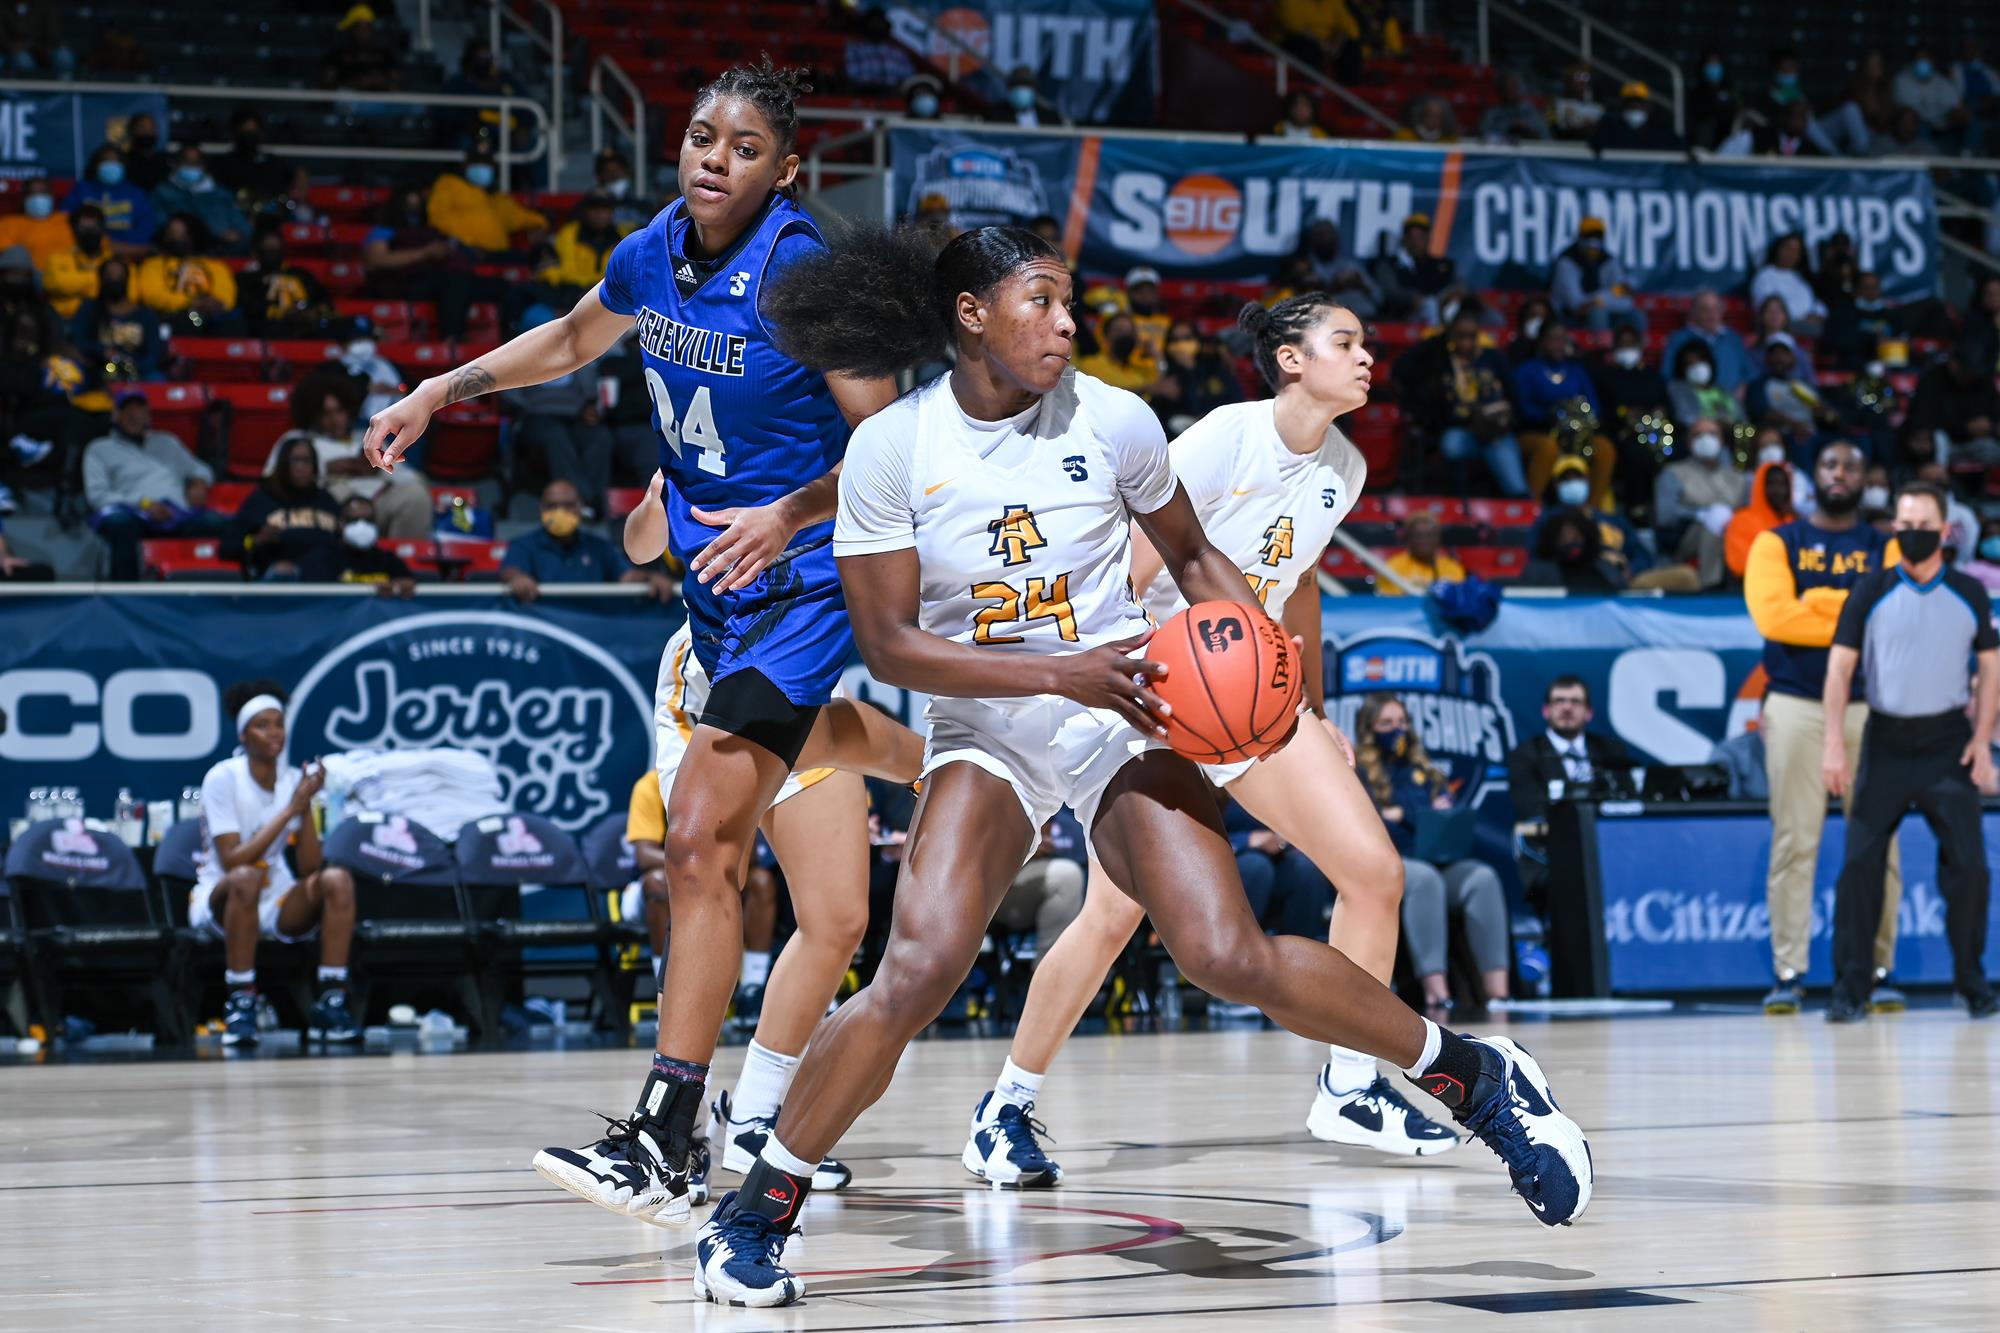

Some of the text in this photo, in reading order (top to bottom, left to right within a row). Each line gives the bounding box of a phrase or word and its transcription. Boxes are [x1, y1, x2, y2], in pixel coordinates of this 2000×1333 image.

[1163, 186, 1243, 222] BIG
[675, 273, 697, 284] adidas
[970, 570, 1080, 646] 24
[408, 635, 540, 664] SINCE 1956
[325, 660, 612, 764] Jersey
